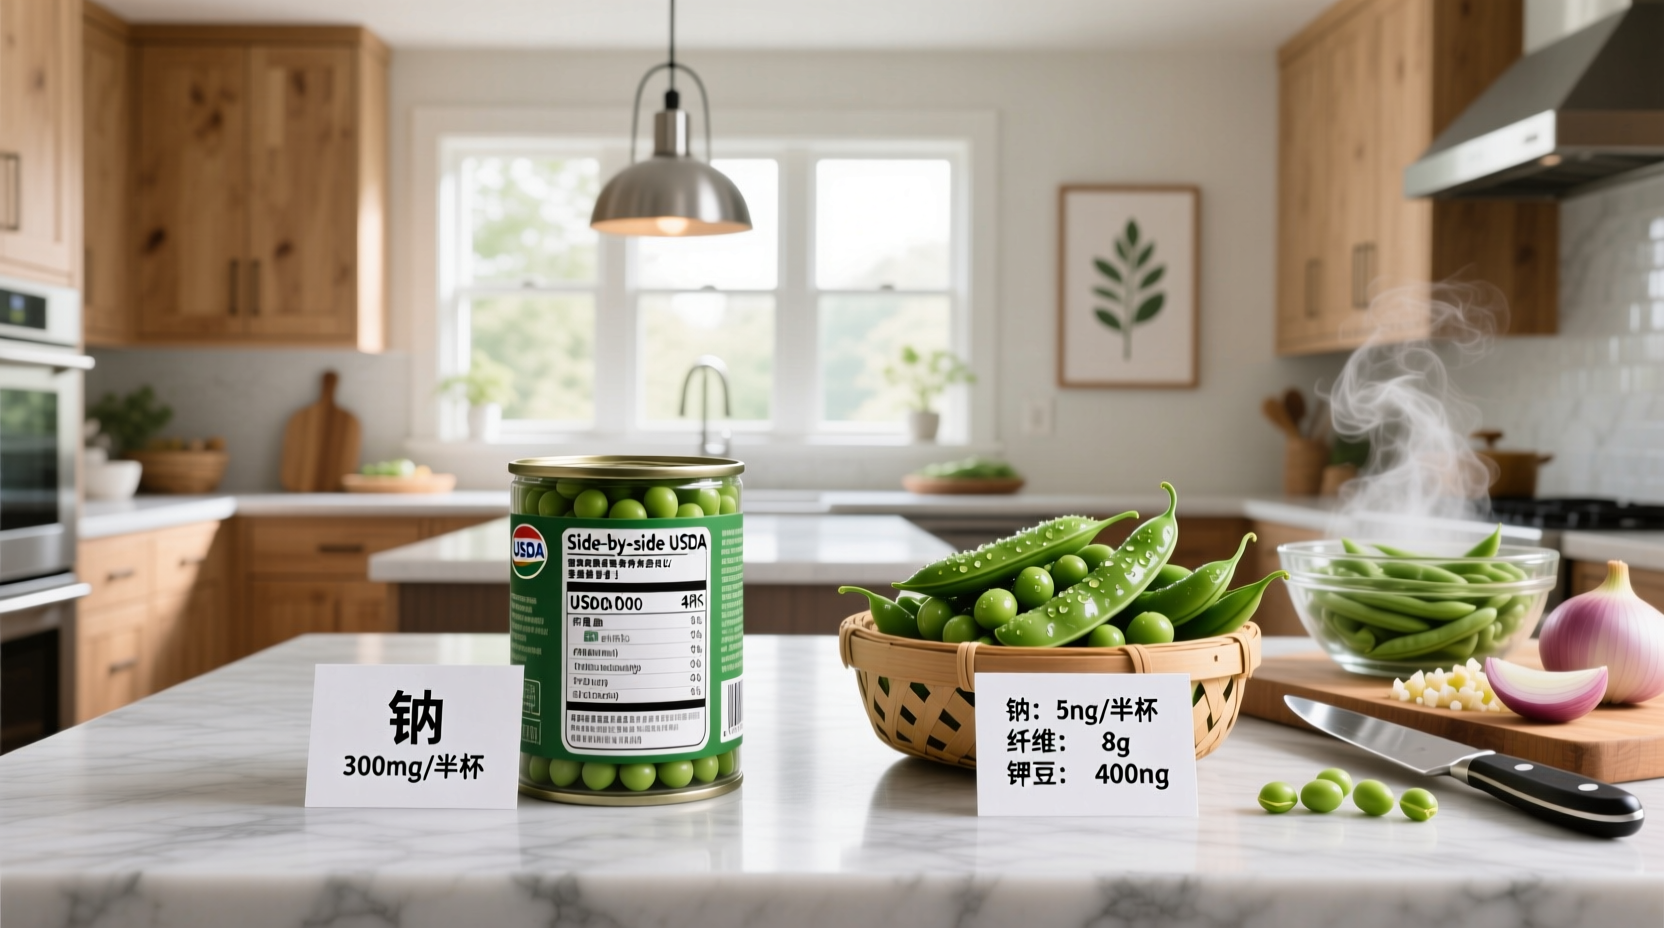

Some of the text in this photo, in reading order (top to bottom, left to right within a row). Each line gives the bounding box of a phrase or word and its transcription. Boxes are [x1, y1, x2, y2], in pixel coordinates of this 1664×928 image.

[513, 541, 545, 559] USDA
[567, 533, 707, 556] Side-by-side USDA
[388, 689, 444, 745] 钠
[1006, 728, 1131, 758] 纤维： 8g
[343, 752, 485, 783] 300mg/半杯
[1006, 760, 1169, 790] 钾豆： 400ng
